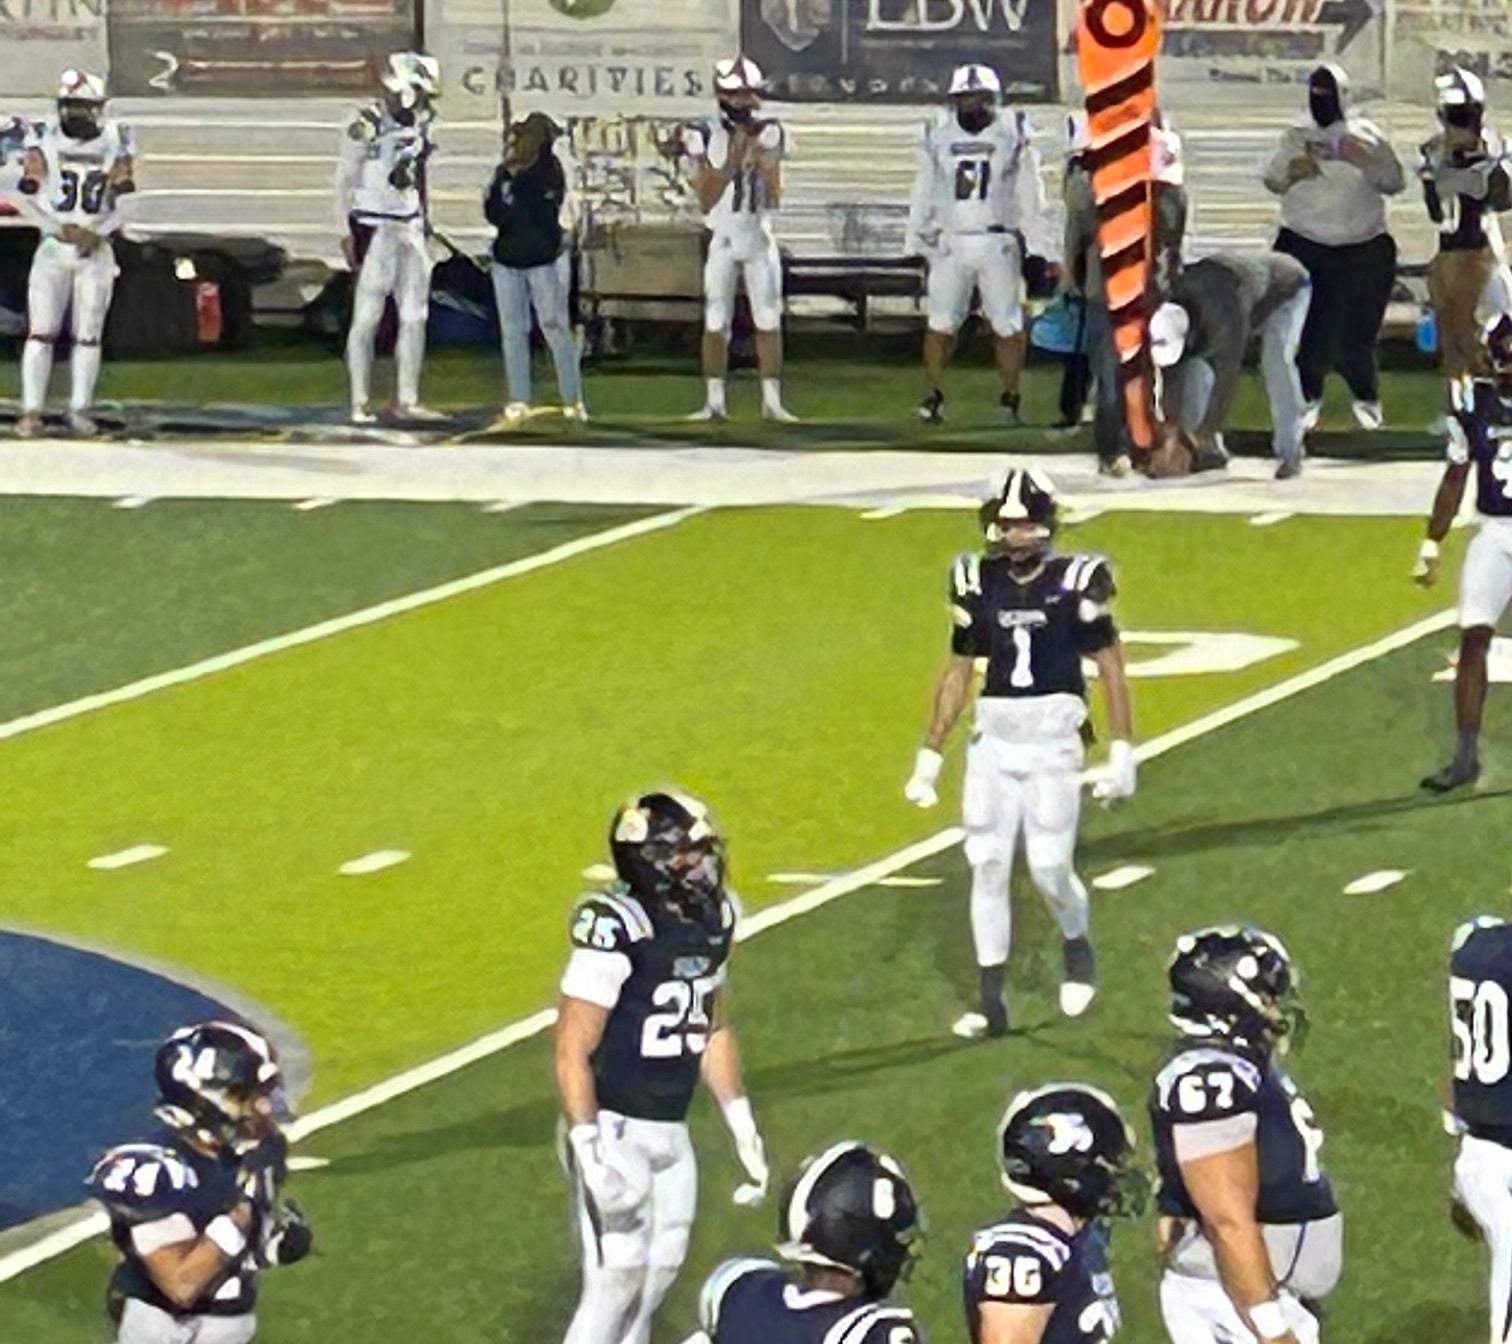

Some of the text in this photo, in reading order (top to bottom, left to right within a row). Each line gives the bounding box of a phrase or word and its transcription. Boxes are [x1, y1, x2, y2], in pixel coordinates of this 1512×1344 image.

[640, 979, 716, 1058] 25
[1449, 976, 1511, 1086] 50
[1178, 1071, 1236, 1115] 67
[983, 1256, 1042, 1297] 36
